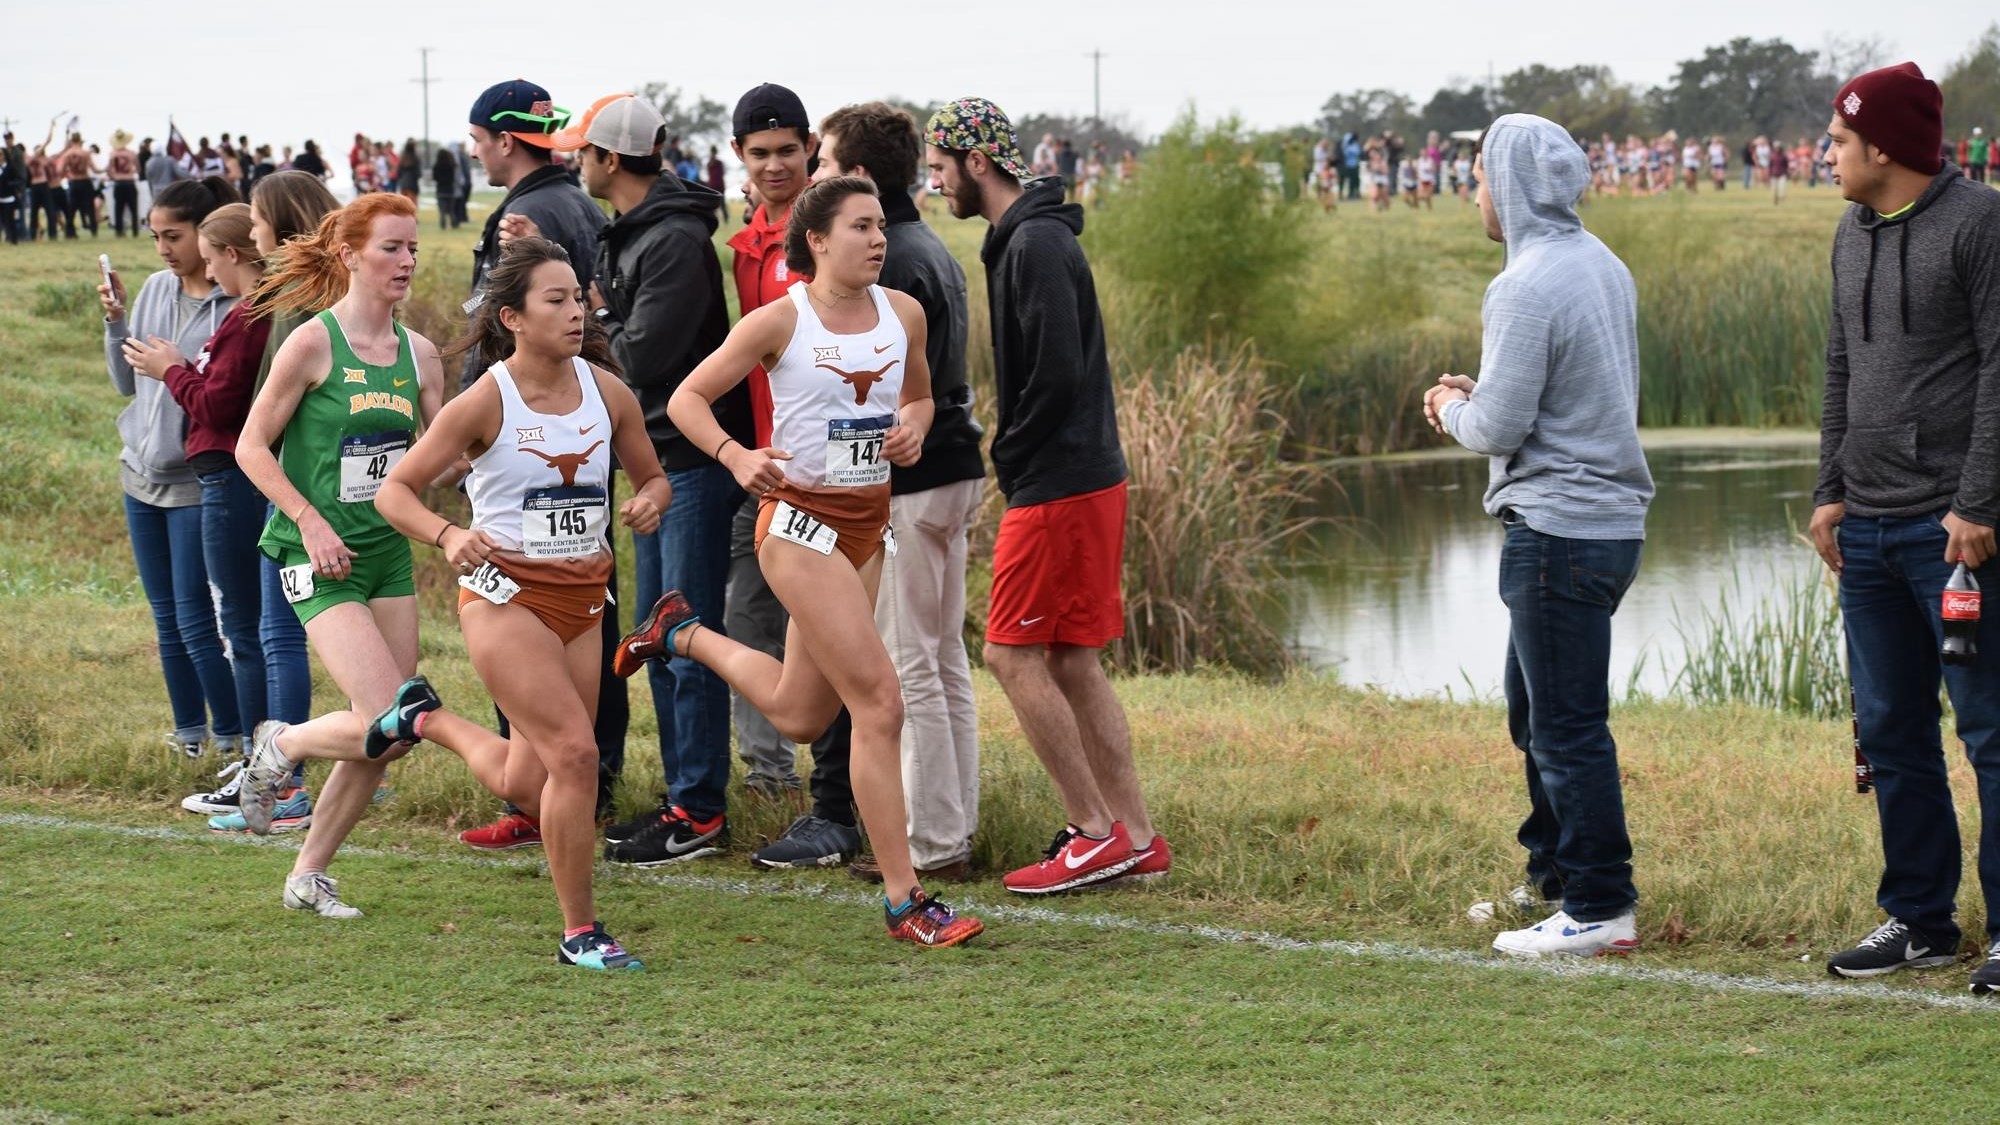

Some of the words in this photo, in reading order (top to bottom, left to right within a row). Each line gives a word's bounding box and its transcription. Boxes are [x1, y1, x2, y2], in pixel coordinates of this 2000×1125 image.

[350, 392, 413, 421] BAYLOR
[850, 439, 882, 466] 147
[367, 454, 388, 480] 42
[546, 509, 587, 537] 145
[783, 509, 822, 543] 147
[537, 547, 571, 555] NOVEMBER
[553, 539, 579, 547] CENTRAL
[283, 569, 301, 597] 42
[469, 564, 506, 593] 145
